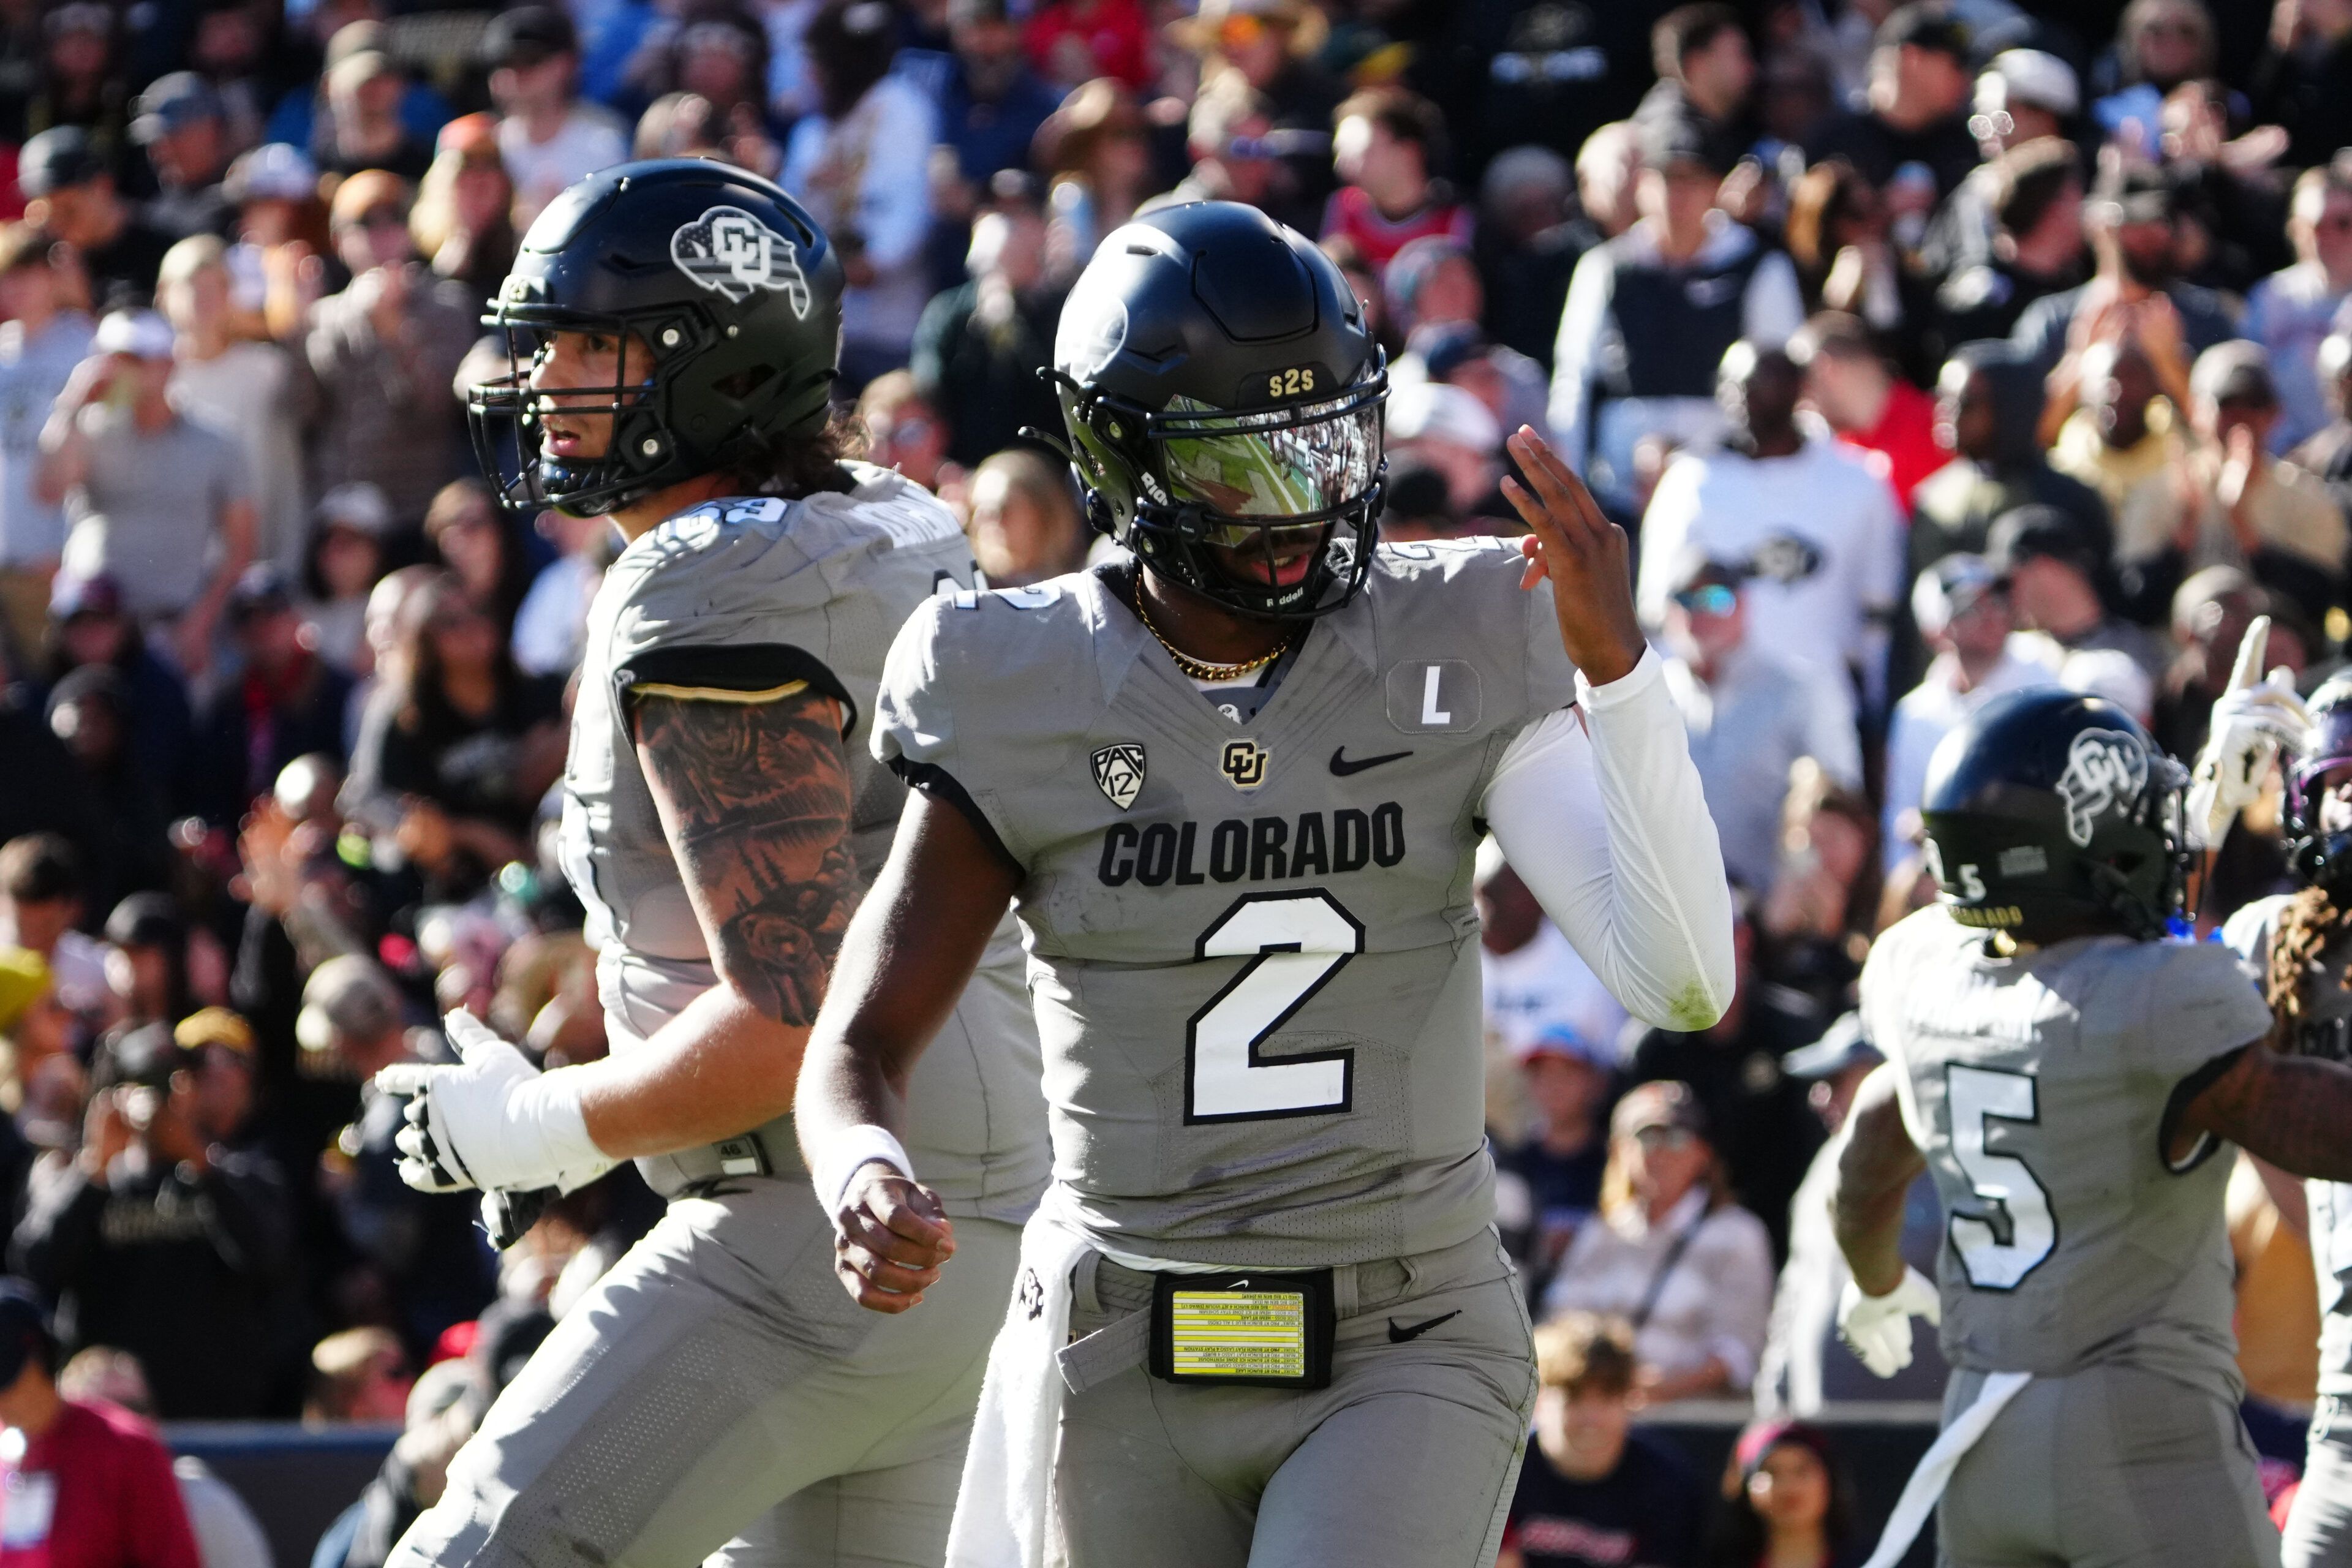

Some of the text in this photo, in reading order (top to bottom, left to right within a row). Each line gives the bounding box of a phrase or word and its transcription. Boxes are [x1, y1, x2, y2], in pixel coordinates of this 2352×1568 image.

[711, 216, 772, 283] CU
[1269, 368, 1314, 397] S2S
[1265, 586, 1303, 608] Rddell
[1422, 665, 1451, 725] L
[1093, 745, 1144, 787] PAC
[1108, 771, 1136, 797] 12
[1222, 741, 1267, 785] CU
[1098, 801, 1406, 887] COLORADO
[1958, 864, 1988, 902] 5
[1183, 886, 1366, 1126] 2
[1945, 1061, 2062, 1294] 5
